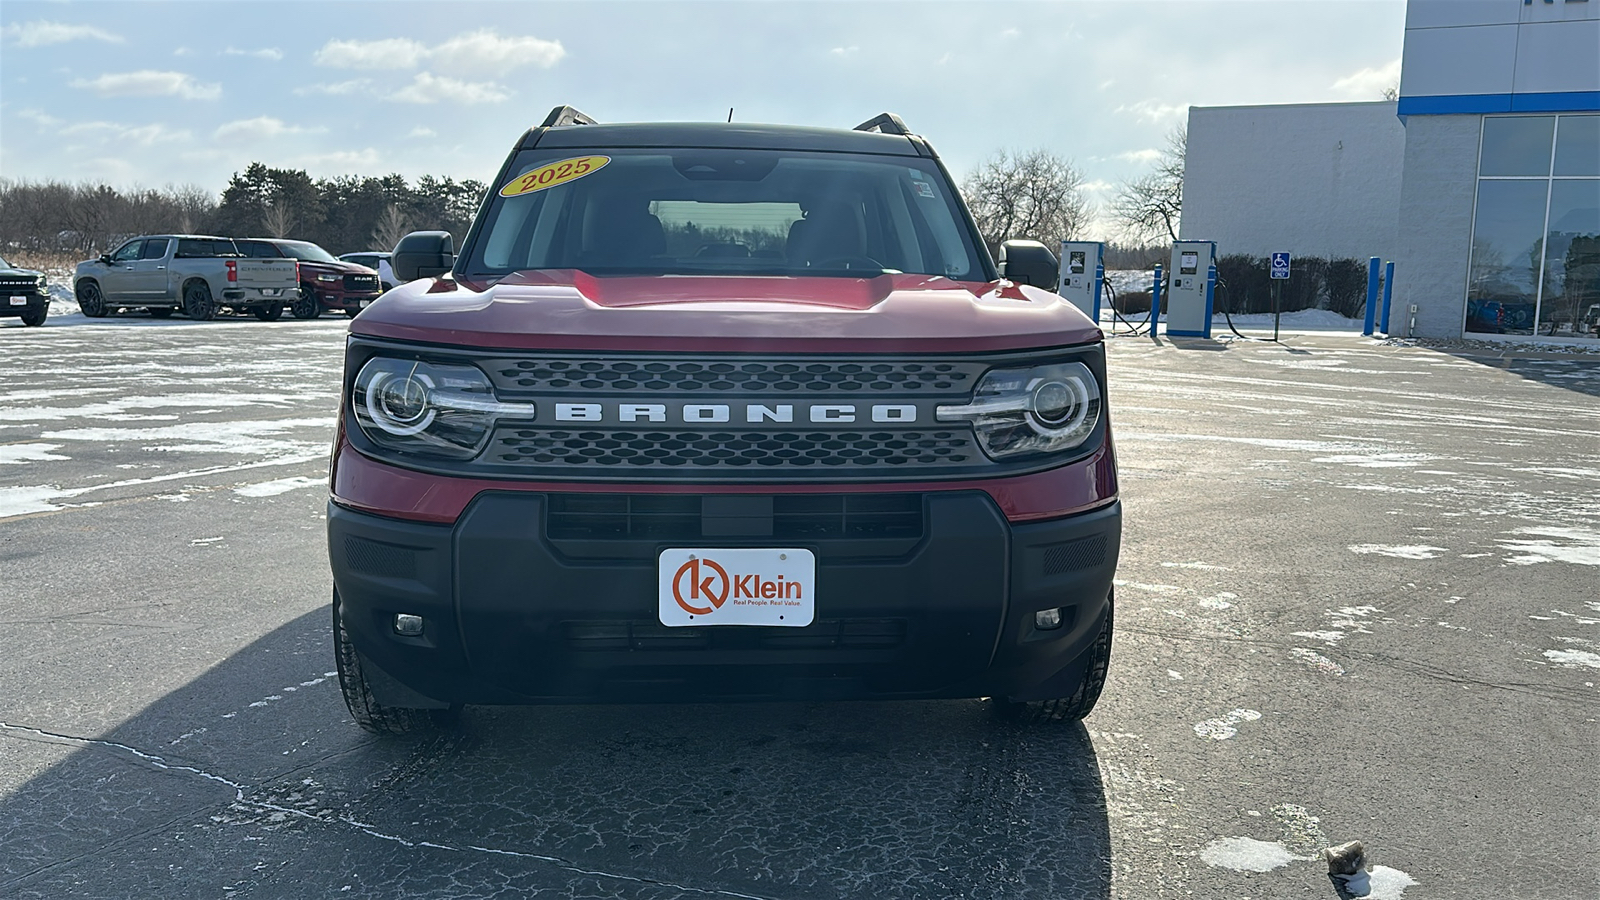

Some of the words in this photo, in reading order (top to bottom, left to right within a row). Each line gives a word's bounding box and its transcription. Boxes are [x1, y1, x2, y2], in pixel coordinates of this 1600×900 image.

[520, 158, 591, 192] 2025
[555, 403, 917, 423] BRONCO
[733, 574, 802, 599] Klein
